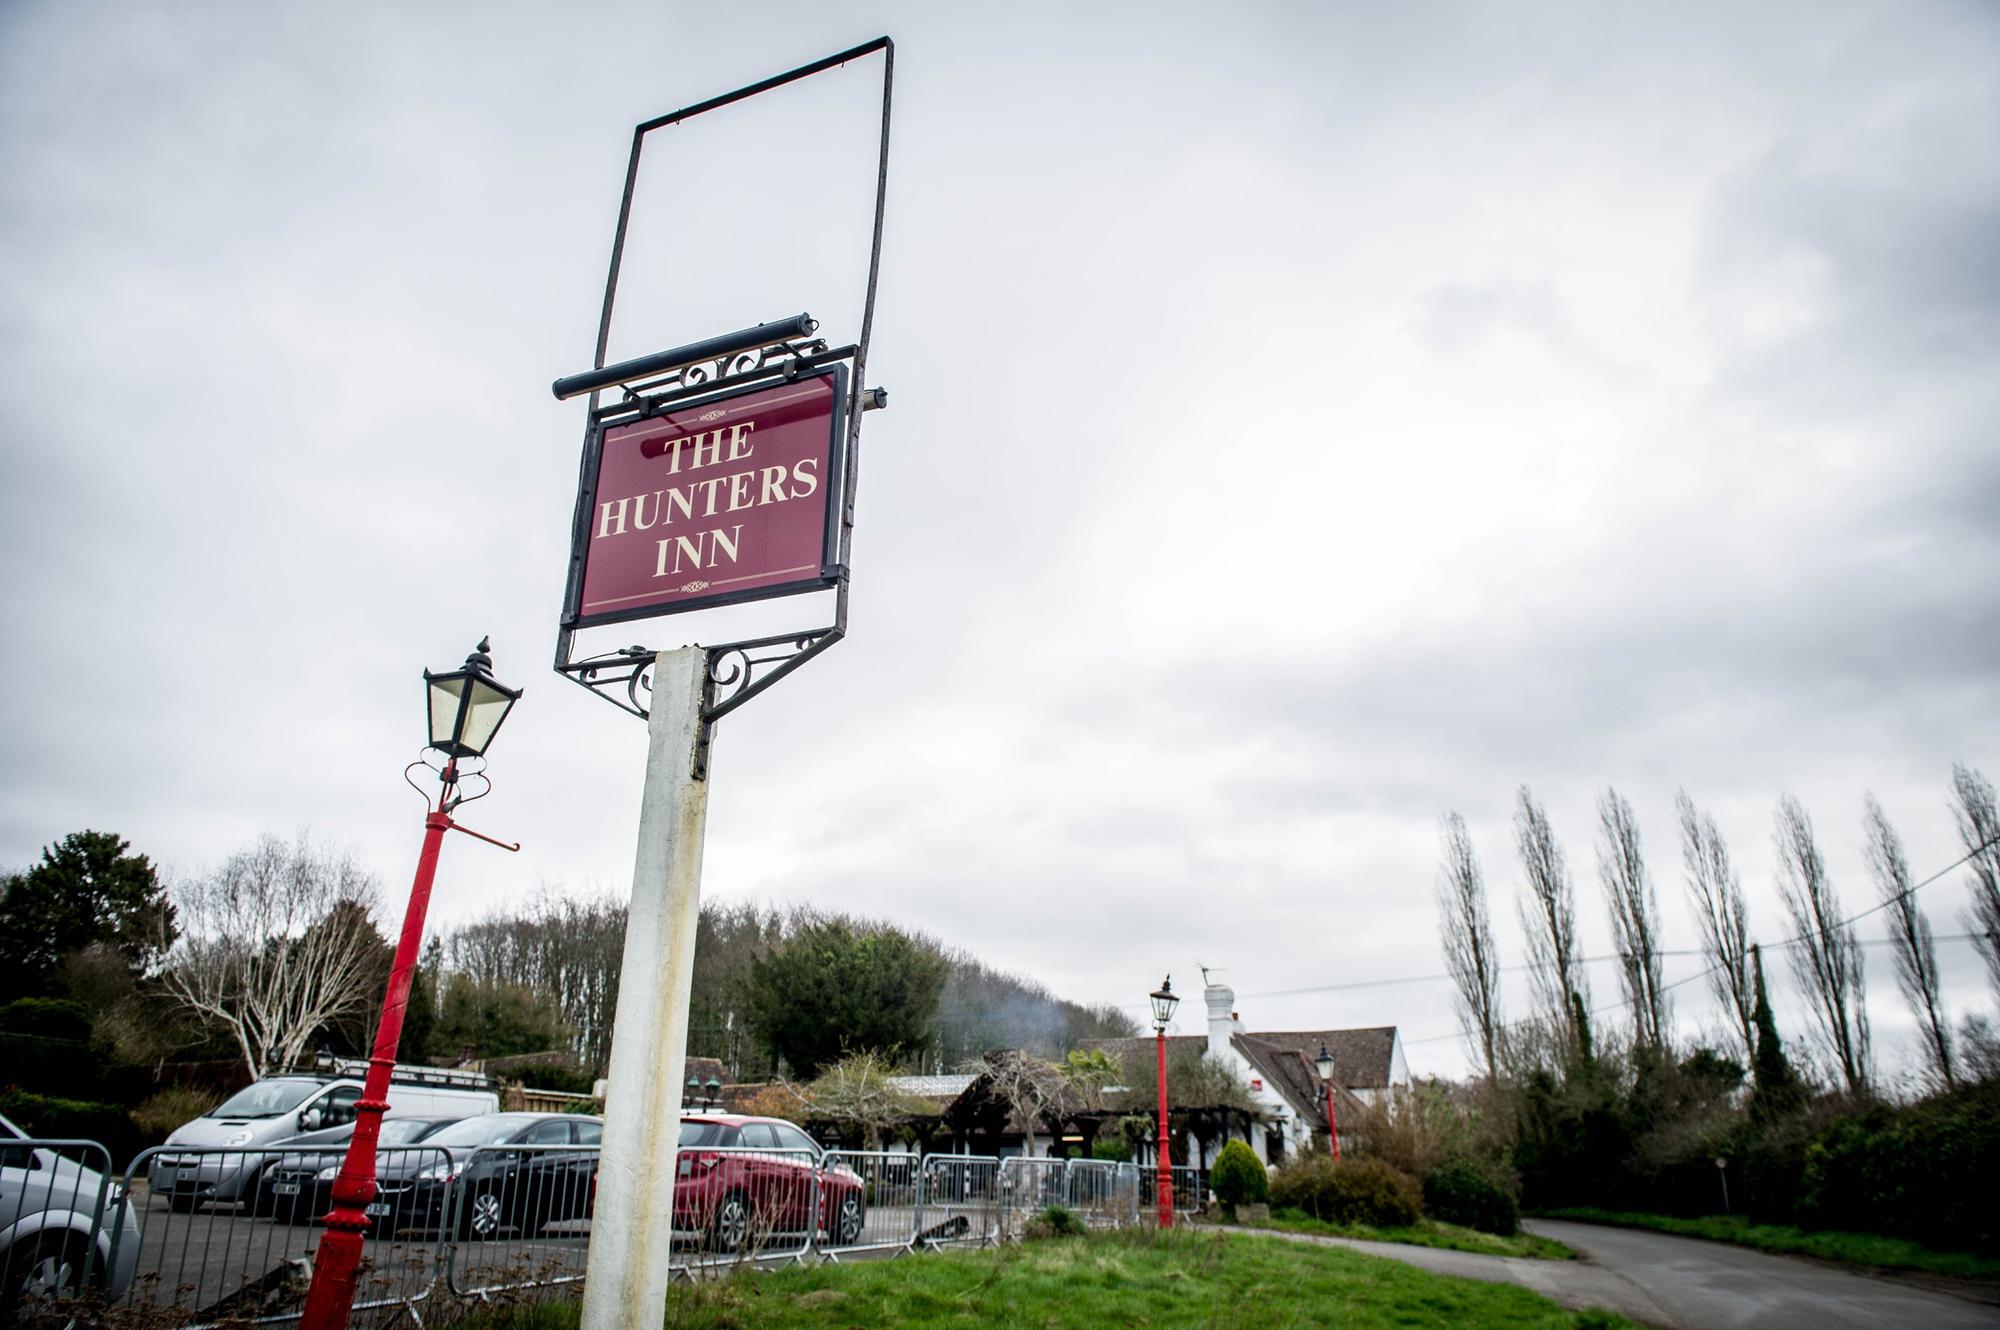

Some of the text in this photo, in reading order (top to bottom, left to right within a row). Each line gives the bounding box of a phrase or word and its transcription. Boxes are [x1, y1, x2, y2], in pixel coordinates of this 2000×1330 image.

[664, 421, 754, 475] THE
[595, 457, 818, 539] HUNTERS
[652, 524, 744, 578] INN
